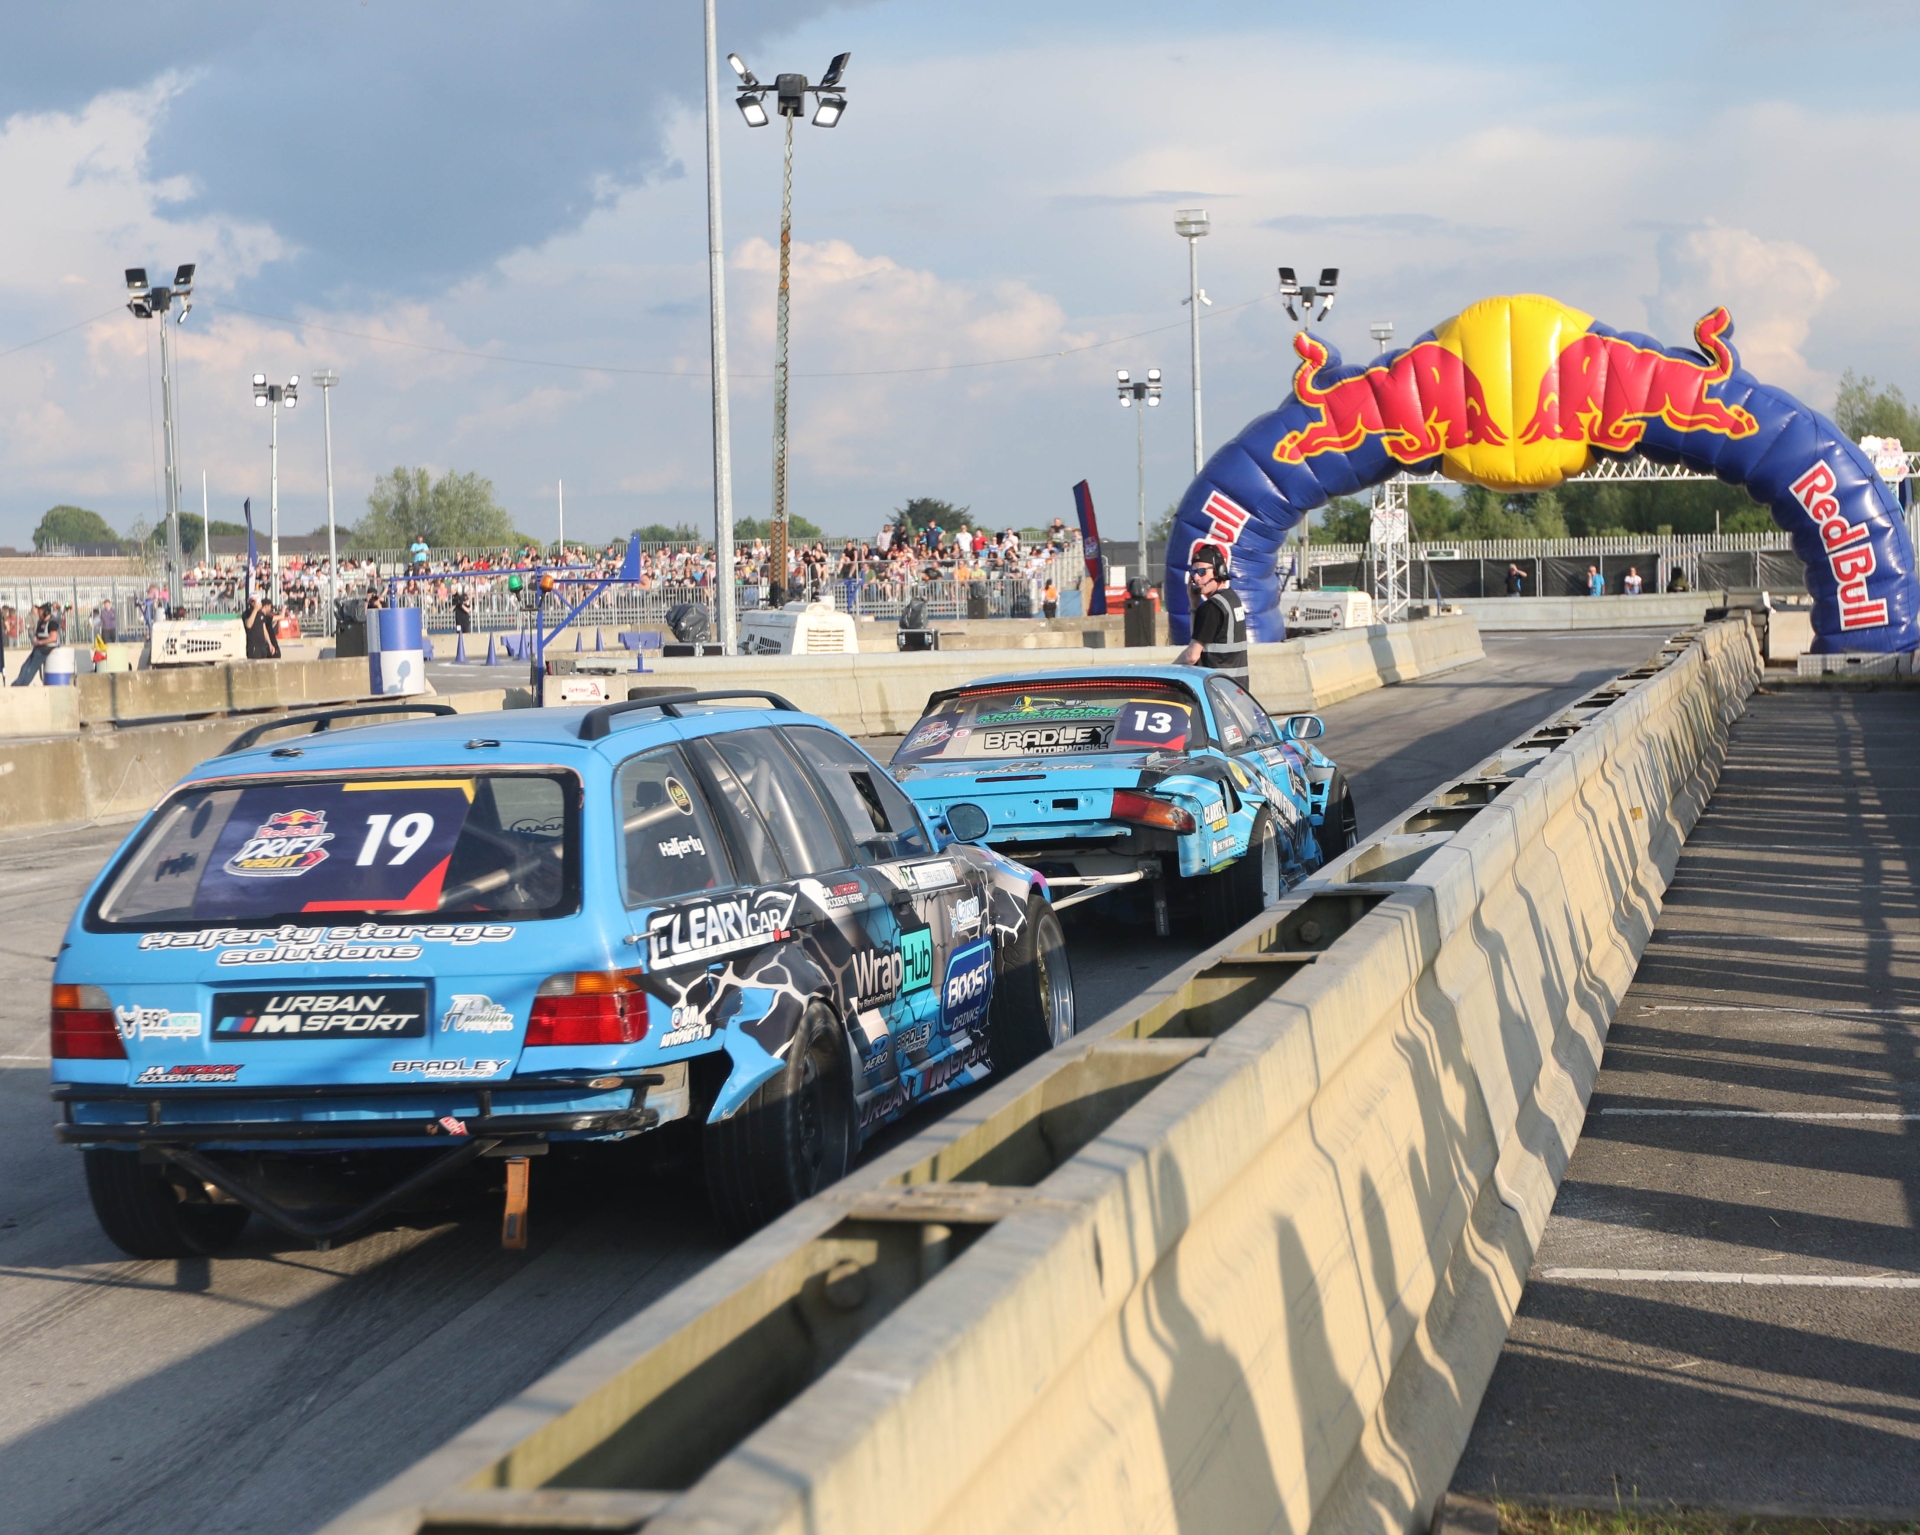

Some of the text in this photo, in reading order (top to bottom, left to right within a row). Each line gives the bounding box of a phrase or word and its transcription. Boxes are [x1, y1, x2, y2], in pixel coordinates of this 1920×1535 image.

[1792, 464, 1886, 628] Red Bull
[1134, 710, 1173, 733] 13
[984, 726, 1115, 750] BRADLEY
[1024, 743, 1109, 755] MOTORWORKS
[260, 825, 320, 838] Red Bull
[355, 812, 435, 867] 19
[235, 836, 323, 862] DRIFT
[658, 835, 706, 859] Halferty
[238, 853, 305, 869] PURSUIT
[747, 908, 784, 938] CAR
[138, 923, 515, 951] Halferty storage
[699, 935, 761, 958] SALES
[217, 943, 424, 966] solutions
[948, 961, 991, 1010] BOOST
[265, 995, 386, 1013] URBAN
[951, 1007, 981, 1032] DRINKS
[897, 1021, 934, 1053] BRADLEY
[168, 1064, 244, 1075] AUTOBODY
[390, 1057, 510, 1073] BRADLEY
[864, 1052, 888, 1071] AERO
[135, 1073, 237, 1084] ACCIDENT REPAIR
[859, 1072, 914, 1128] URBAN
